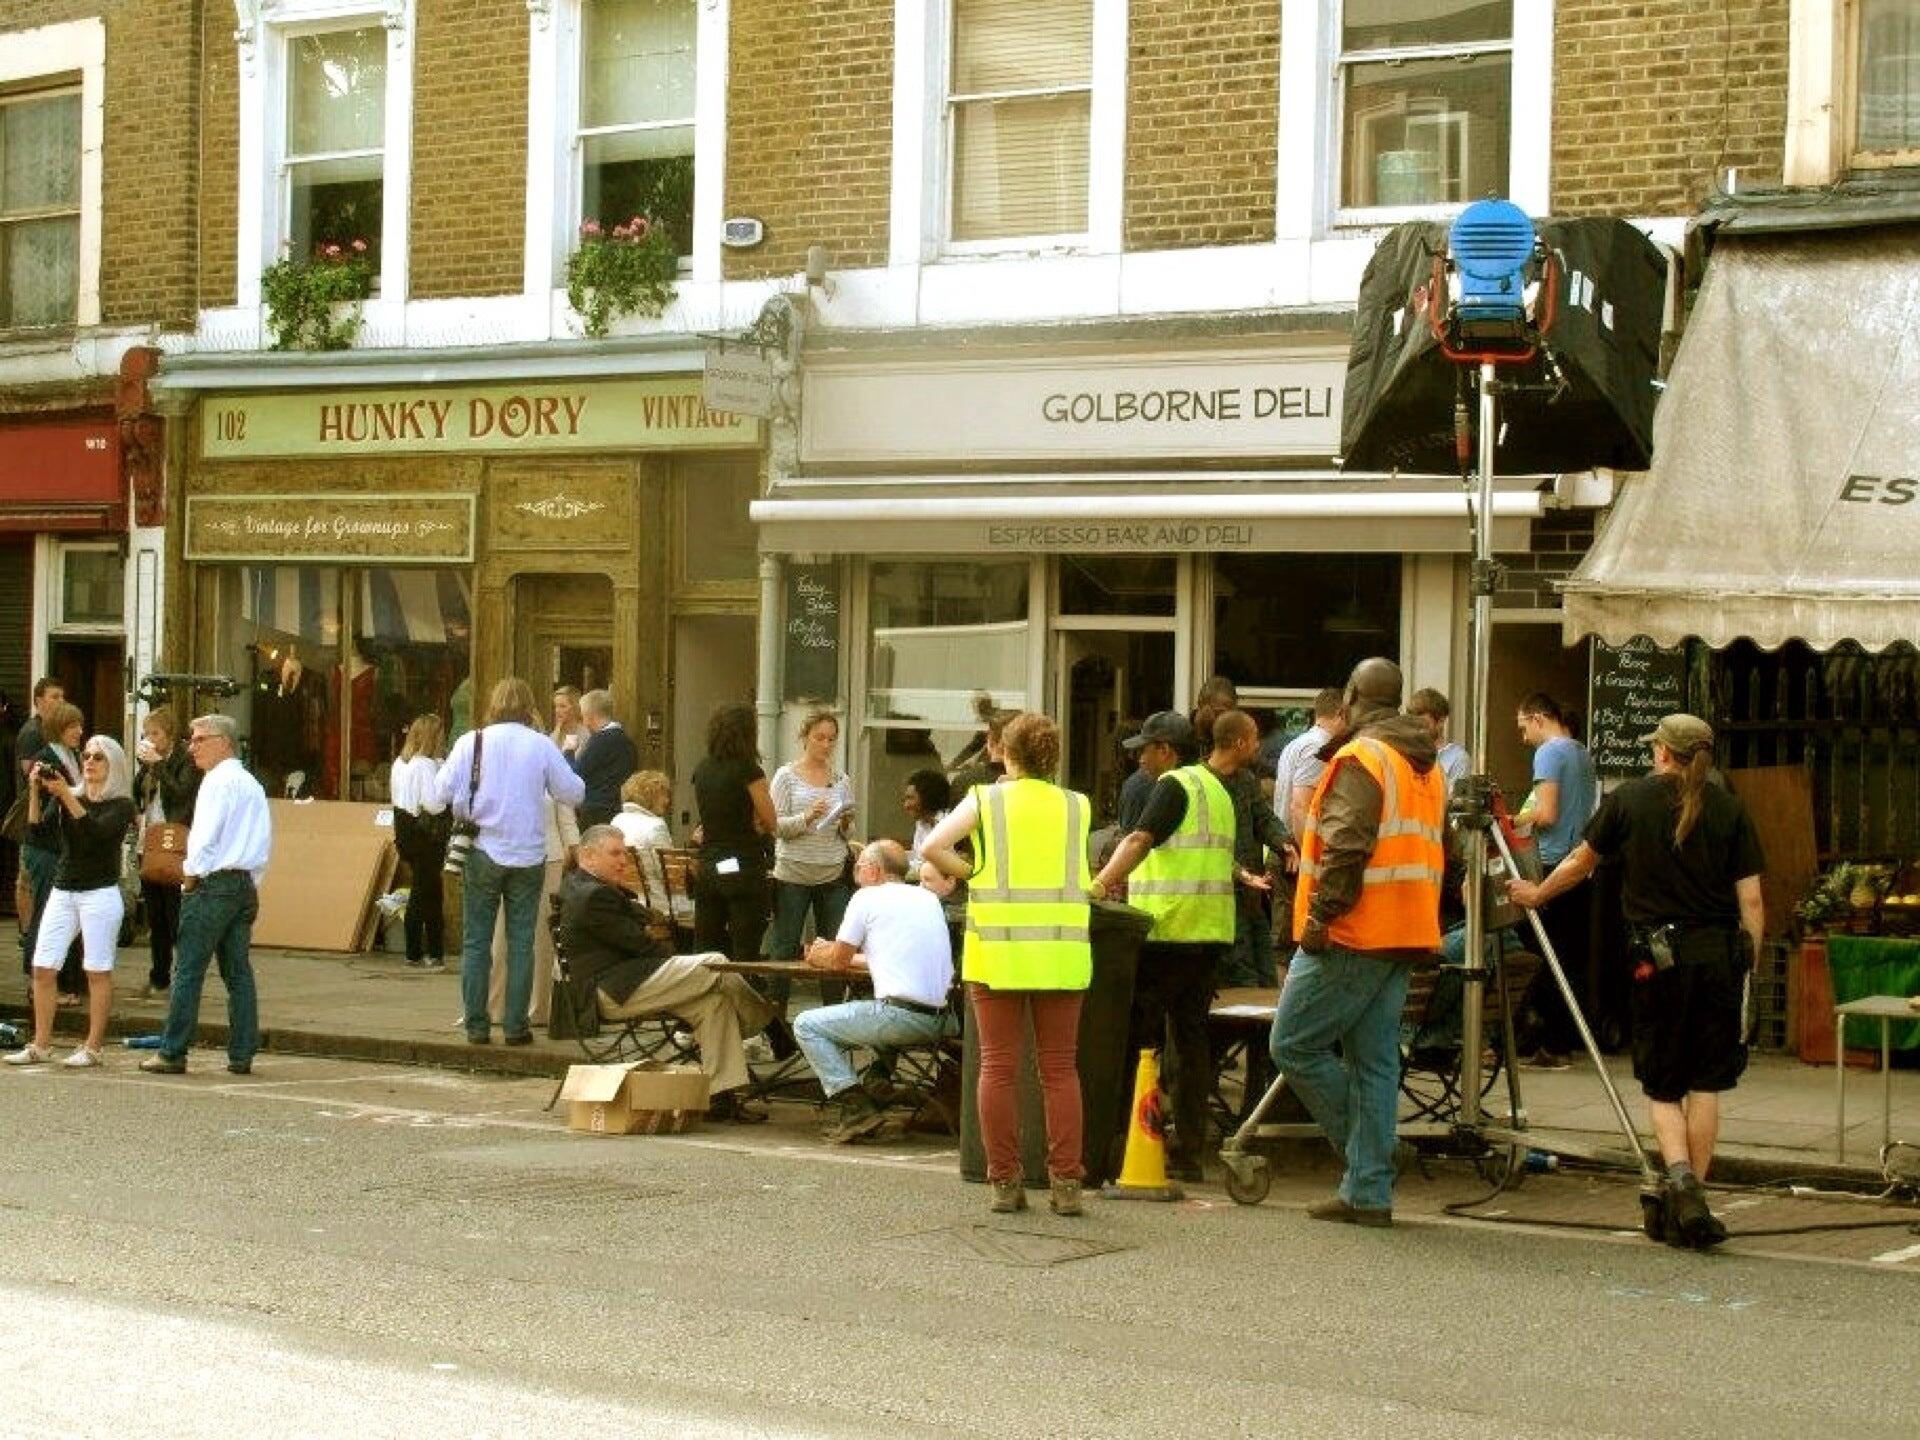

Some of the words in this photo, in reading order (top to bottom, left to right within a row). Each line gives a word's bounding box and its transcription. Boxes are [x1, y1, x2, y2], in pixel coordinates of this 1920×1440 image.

[319, 399, 452, 442] HUNKY
[469, 396, 587, 438] DORY
[1042, 389, 1241, 423] GOLBORNE
[1254, 387, 1331, 418] DELI
[216, 410, 246, 441] 102
[1840, 475, 1919, 505] ES
[245, 516, 300, 538] Vintage
[304, 515, 327, 539] for
[332, 515, 410, 540] Grownups
[988, 526, 1100, 544] ESPRESSO
[1106, 527, 1151, 544] BAR
[1154, 526, 1199, 544] AND
[1205, 526, 1254, 544] DELI
